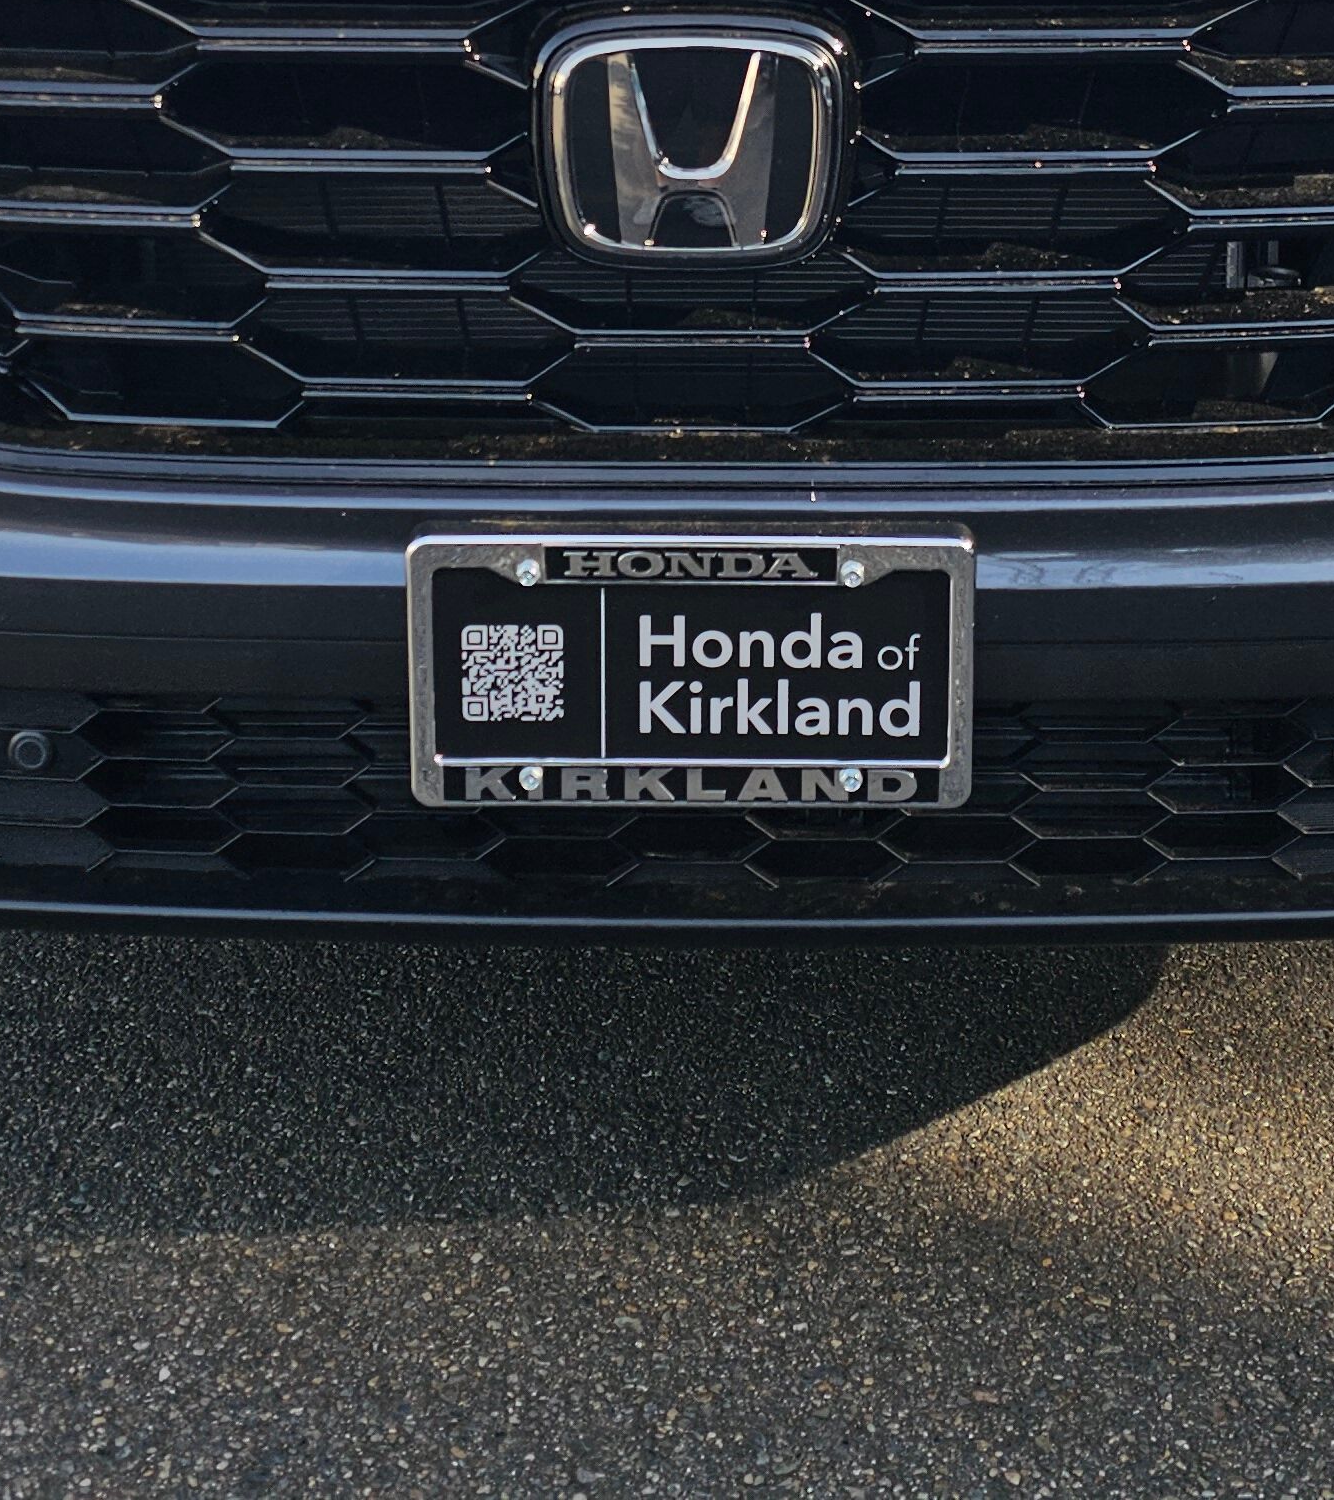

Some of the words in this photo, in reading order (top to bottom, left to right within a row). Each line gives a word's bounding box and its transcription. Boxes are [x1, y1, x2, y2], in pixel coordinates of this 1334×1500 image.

[564, 551, 818, 579] HONDA
[639, 612, 864, 669] Honda
[876, 633, 921, 671] of
[639, 678, 921, 737] Kirkland
